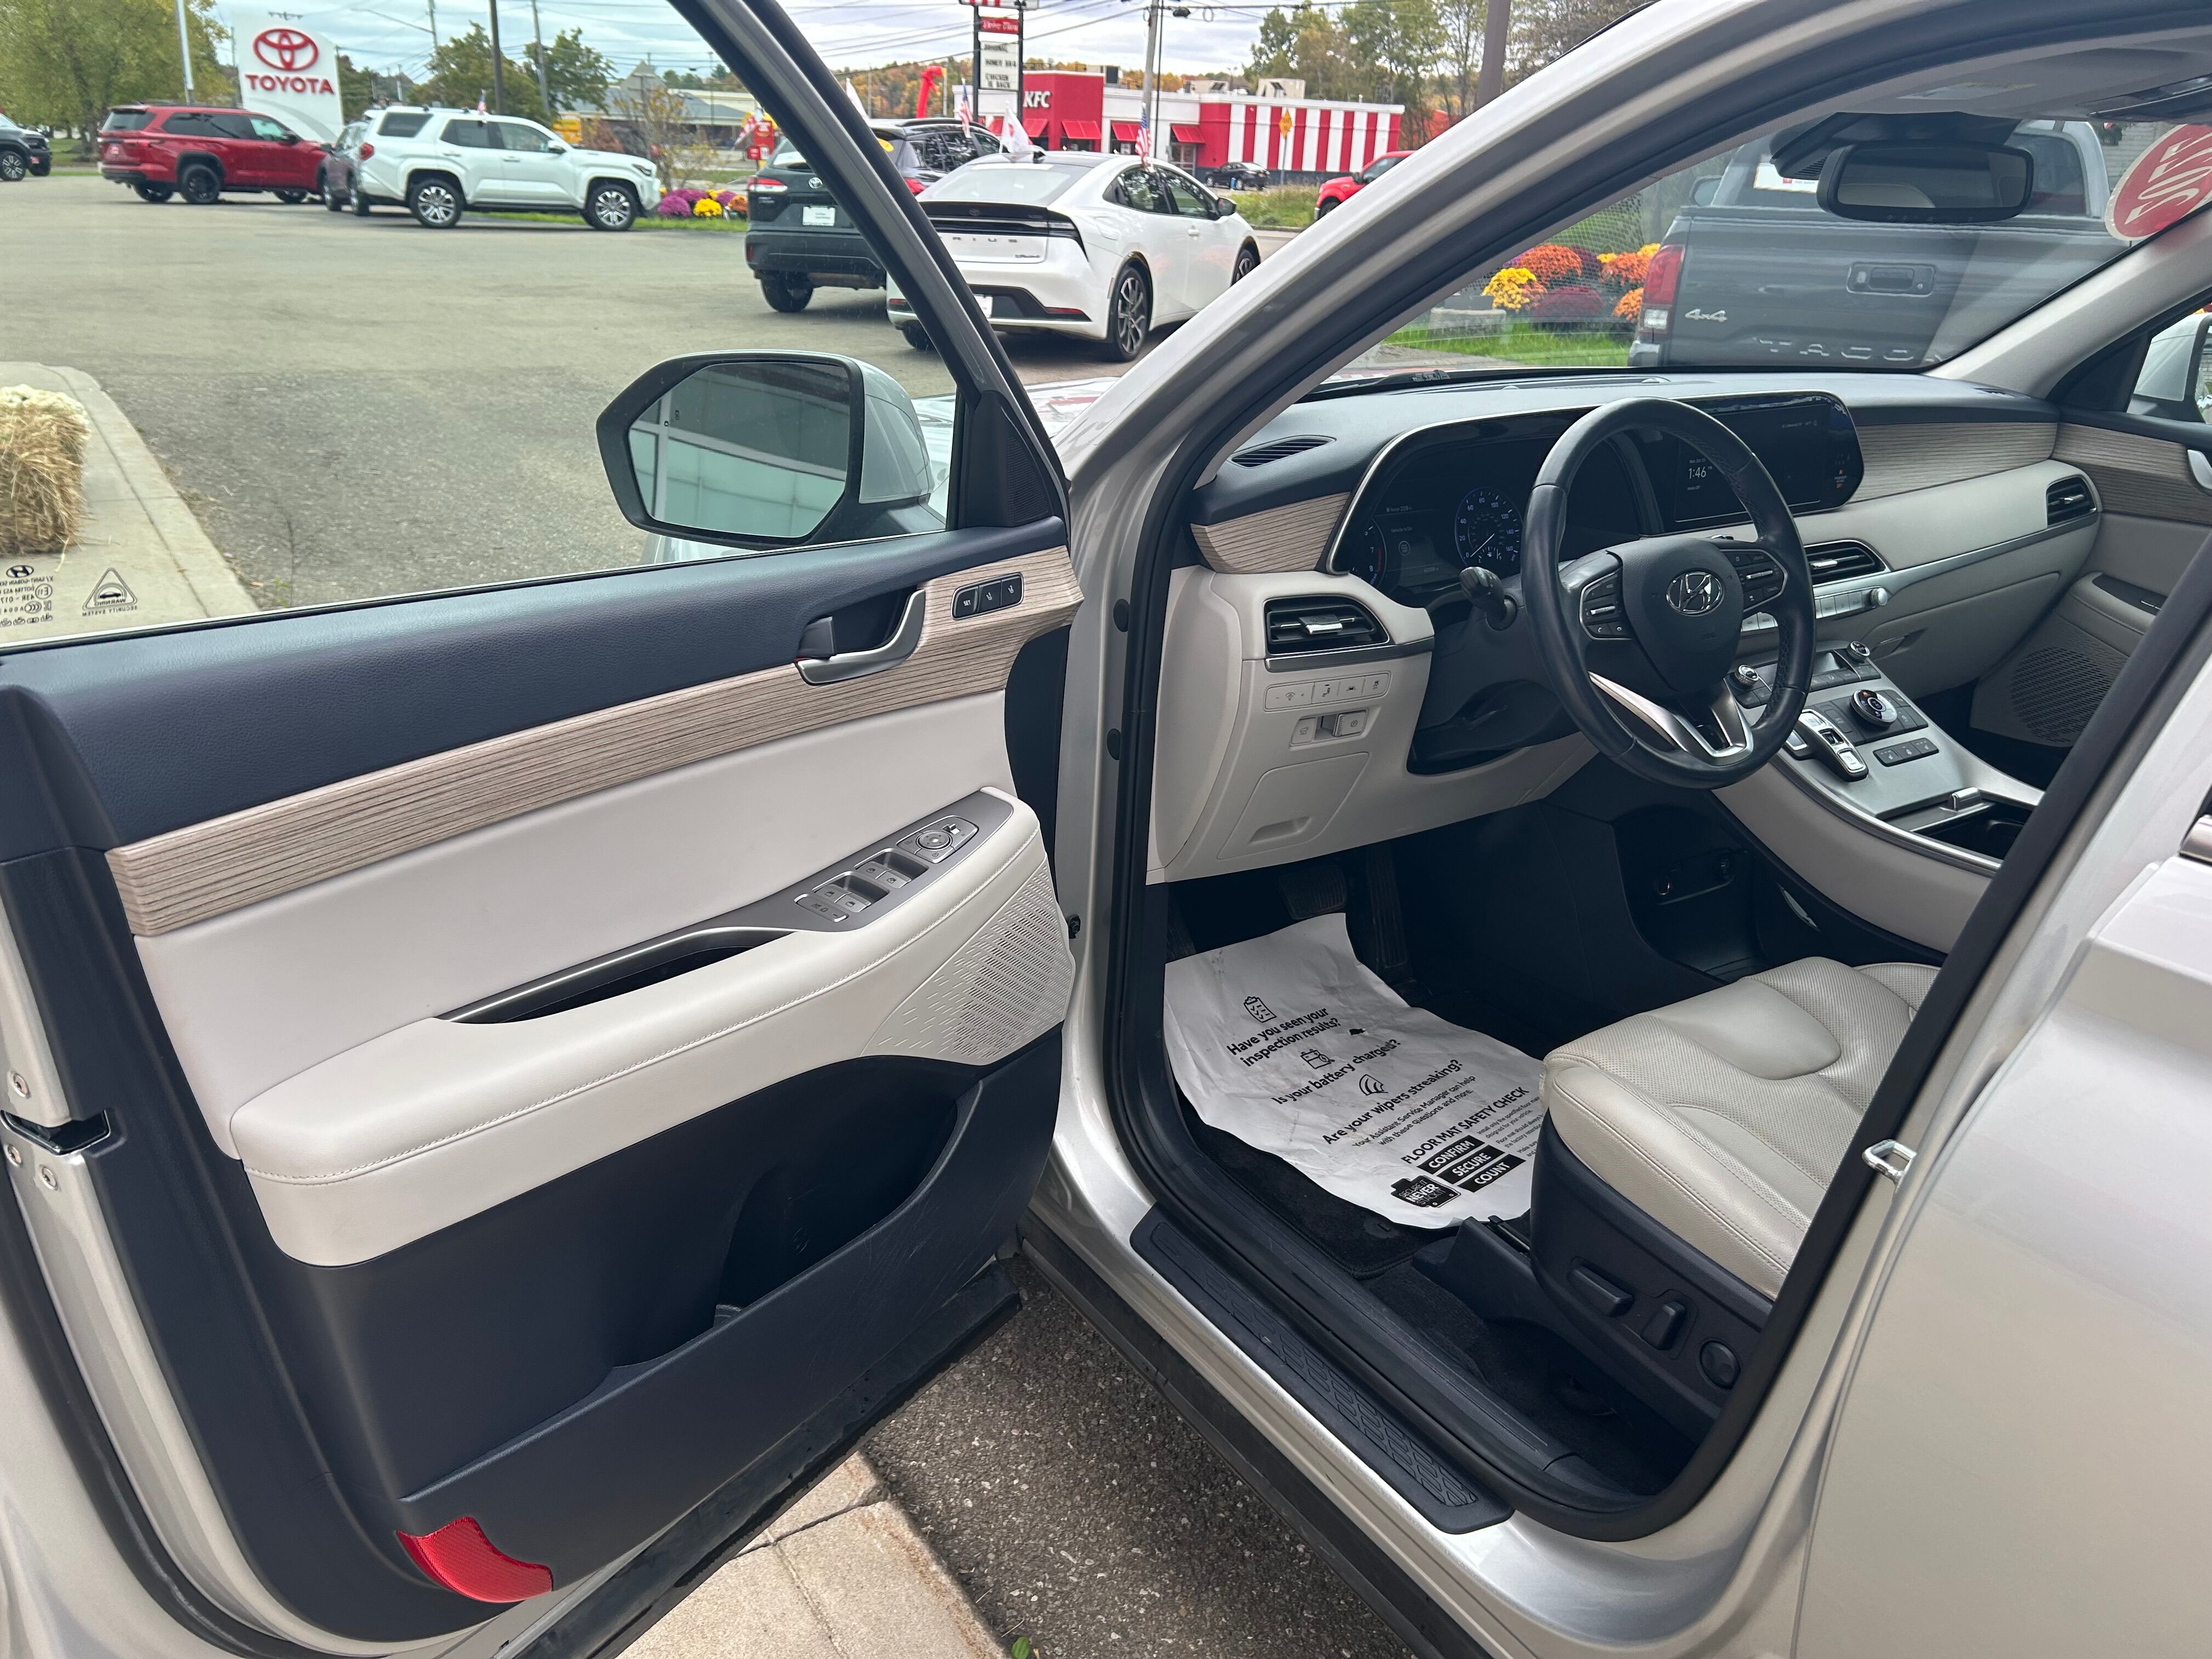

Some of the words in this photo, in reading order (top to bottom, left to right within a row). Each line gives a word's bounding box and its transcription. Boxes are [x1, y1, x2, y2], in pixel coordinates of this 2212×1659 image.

[245, 74, 335, 95] TOYOTA
[1023, 91, 1051, 108] KFC
[1684, 308, 1728, 322] 4x4
[1689, 466, 1707, 479] 1:46
[1227, 1037, 1260, 1055] Have
[1257, 1026, 1282, 1041] you
[1279, 1016, 1306, 1030] seen
[1304, 1008, 1329, 1024] your
[1240, 1036, 1304, 1067] inspection
[1301, 1018, 1341, 1038] results?
[1271, 1096, 1288, 1104] Is
[1284, 1084, 1313, 1102] your
[1308, 1063, 1356, 1089] battery
[1352, 1039, 1401, 1064] charged?
[1322, 1130, 1346, 1145] Are
[1344, 1111, 1373, 1130] your
[1370, 1092, 1410, 1114] wipers
[1407, 1059, 1463, 1095] streaking?
[1352, 1137, 1371, 1147] Your
[1369, 1121, 1401, 1139] Assistant
[1397, 1107, 1423, 1122] Service
[1420, 1091, 1450, 1109] Manager
[1448, 1084, 1462, 1093] can
[1458, 1075, 1476, 1086] help
[1378, 1136, 1396, 1146] with
[1392, 1124, 1413, 1138] these
[1412, 1105, 1443, 1125] questions
[1442, 1097, 1455, 1107] and
[1454, 1090, 1474, 1101] more.
[1401, 1138, 1442, 1164] FLOOR
[1436, 1126, 1463, 1142] MAT
[1458, 1105, 1497, 1130] SAFETY
[1493, 1087, 1530, 1108] CHECK
[1428, 1139, 1475, 1168] CONFIRM
[1452, 1152, 1492, 1177] SECURE
[1474, 1161, 1510, 1184] COUNT
[1398, 1182, 1424, 1198] SECURE
[1405, 1183, 1440, 1202] NEVER
